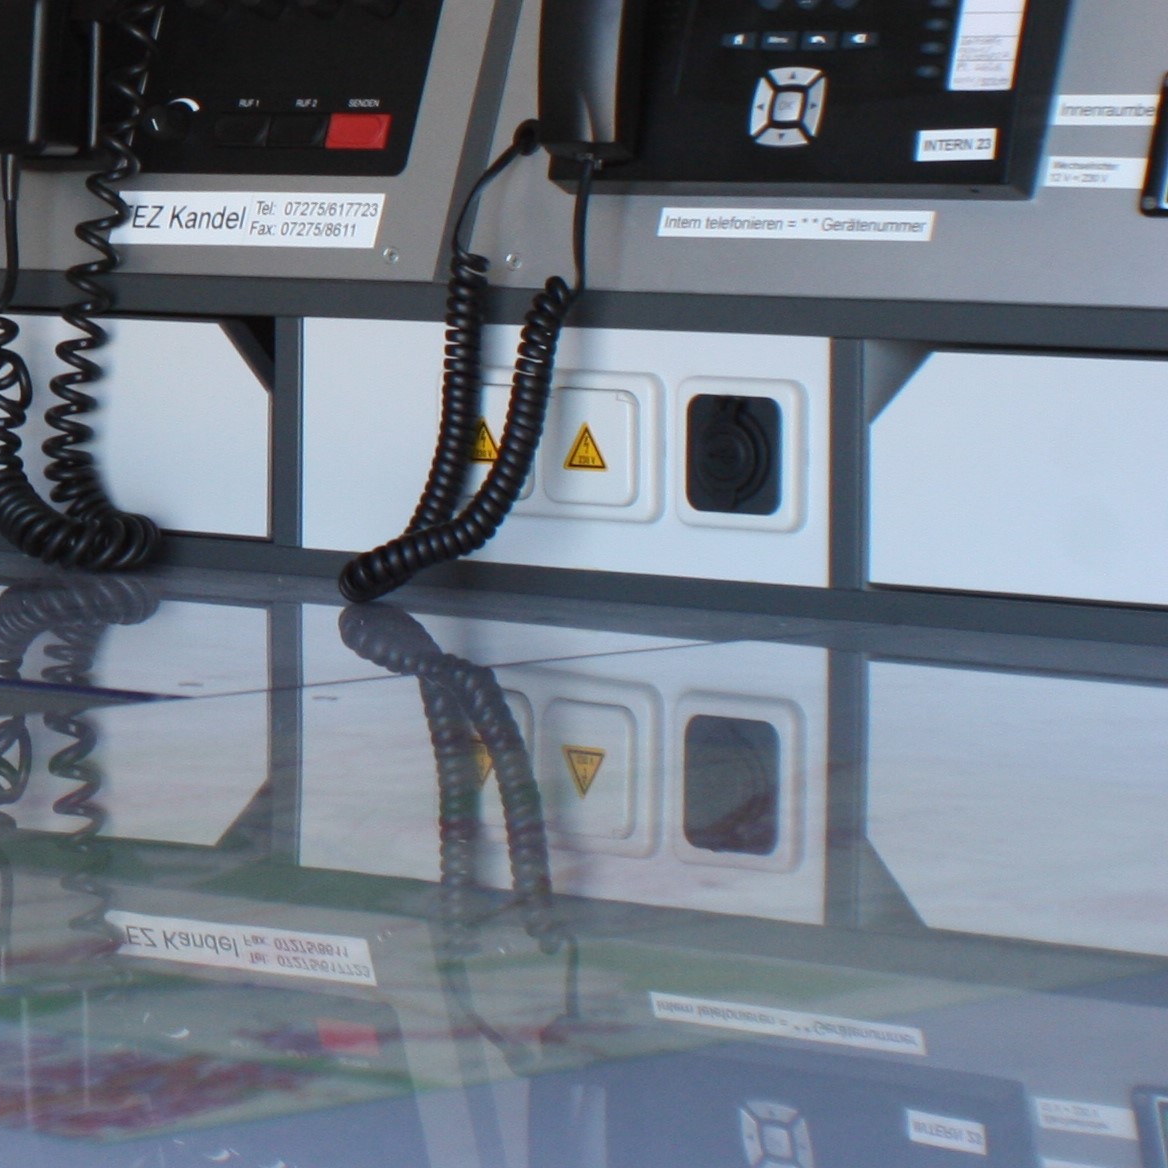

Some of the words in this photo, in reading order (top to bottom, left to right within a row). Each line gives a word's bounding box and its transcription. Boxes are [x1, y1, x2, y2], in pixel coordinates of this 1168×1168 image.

[923, 138, 974, 152] INTERN
[975, 137, 992, 150] 23
[129, 205, 164, 229] EZ
[169, 205, 247, 230] Kandel
[256, 200, 275, 216] Tel:
[284, 201, 379, 218] 07275/617723
[249, 220, 277, 237] Fax:
[280, 222, 357, 238] 07275/8611
[705, 216, 783, 231] telefonieren
[822, 217, 927, 233] Gerätenummer
